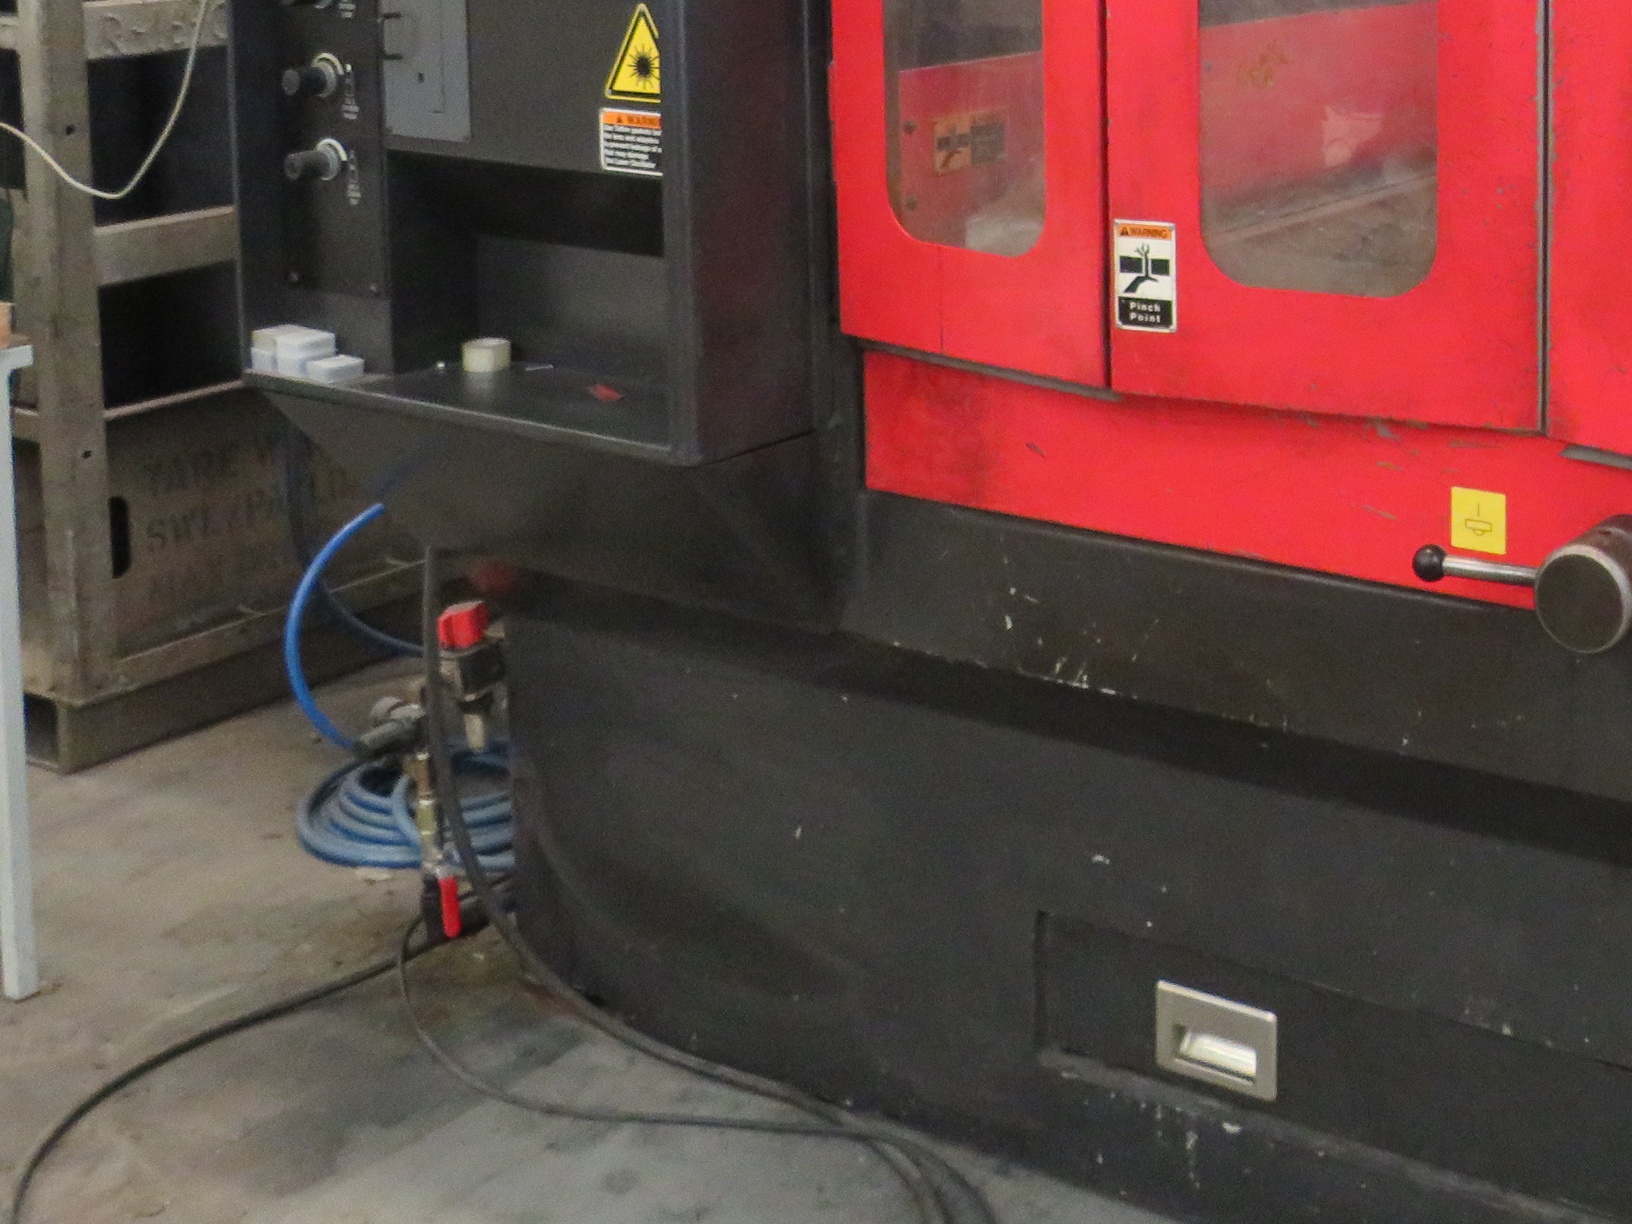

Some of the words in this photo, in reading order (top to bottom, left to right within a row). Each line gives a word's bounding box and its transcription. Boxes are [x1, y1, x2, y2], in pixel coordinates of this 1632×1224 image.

[1130, 226, 1168, 239] WARNING
[1129, 301, 1161, 313] Pinch
[1129, 311, 1161, 323] Point
